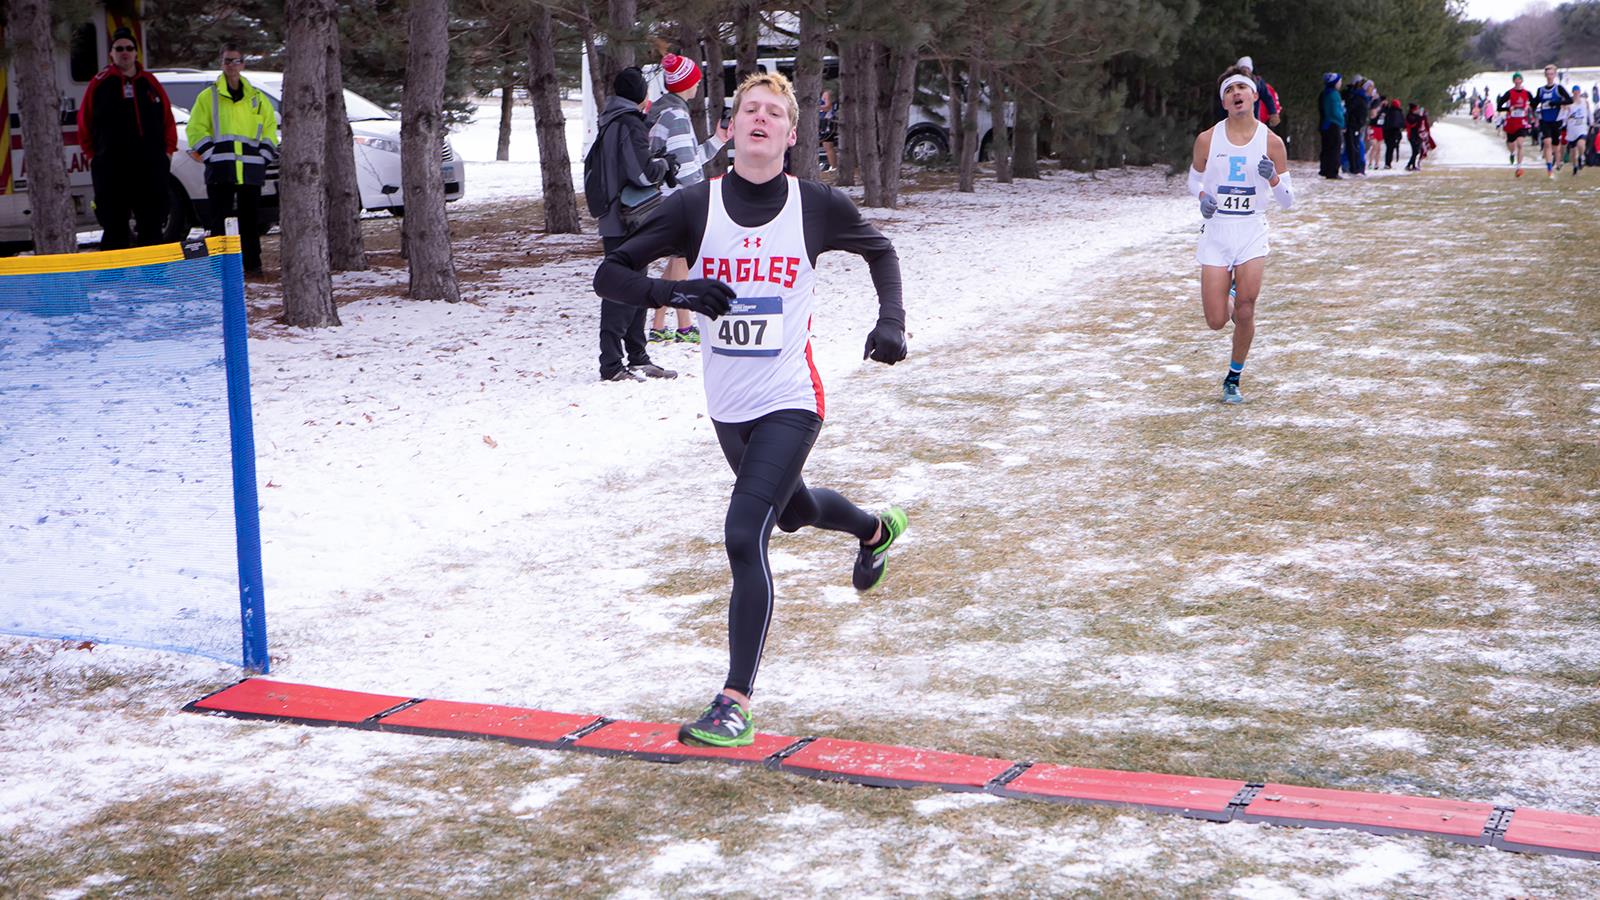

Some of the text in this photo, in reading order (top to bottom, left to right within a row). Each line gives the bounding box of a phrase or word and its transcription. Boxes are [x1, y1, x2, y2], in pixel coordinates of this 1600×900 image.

[1228, 156, 1247, 182] E
[1223, 196, 1250, 210] 414
[702, 256, 801, 289] EAGLES
[718, 319, 768, 346] 407
